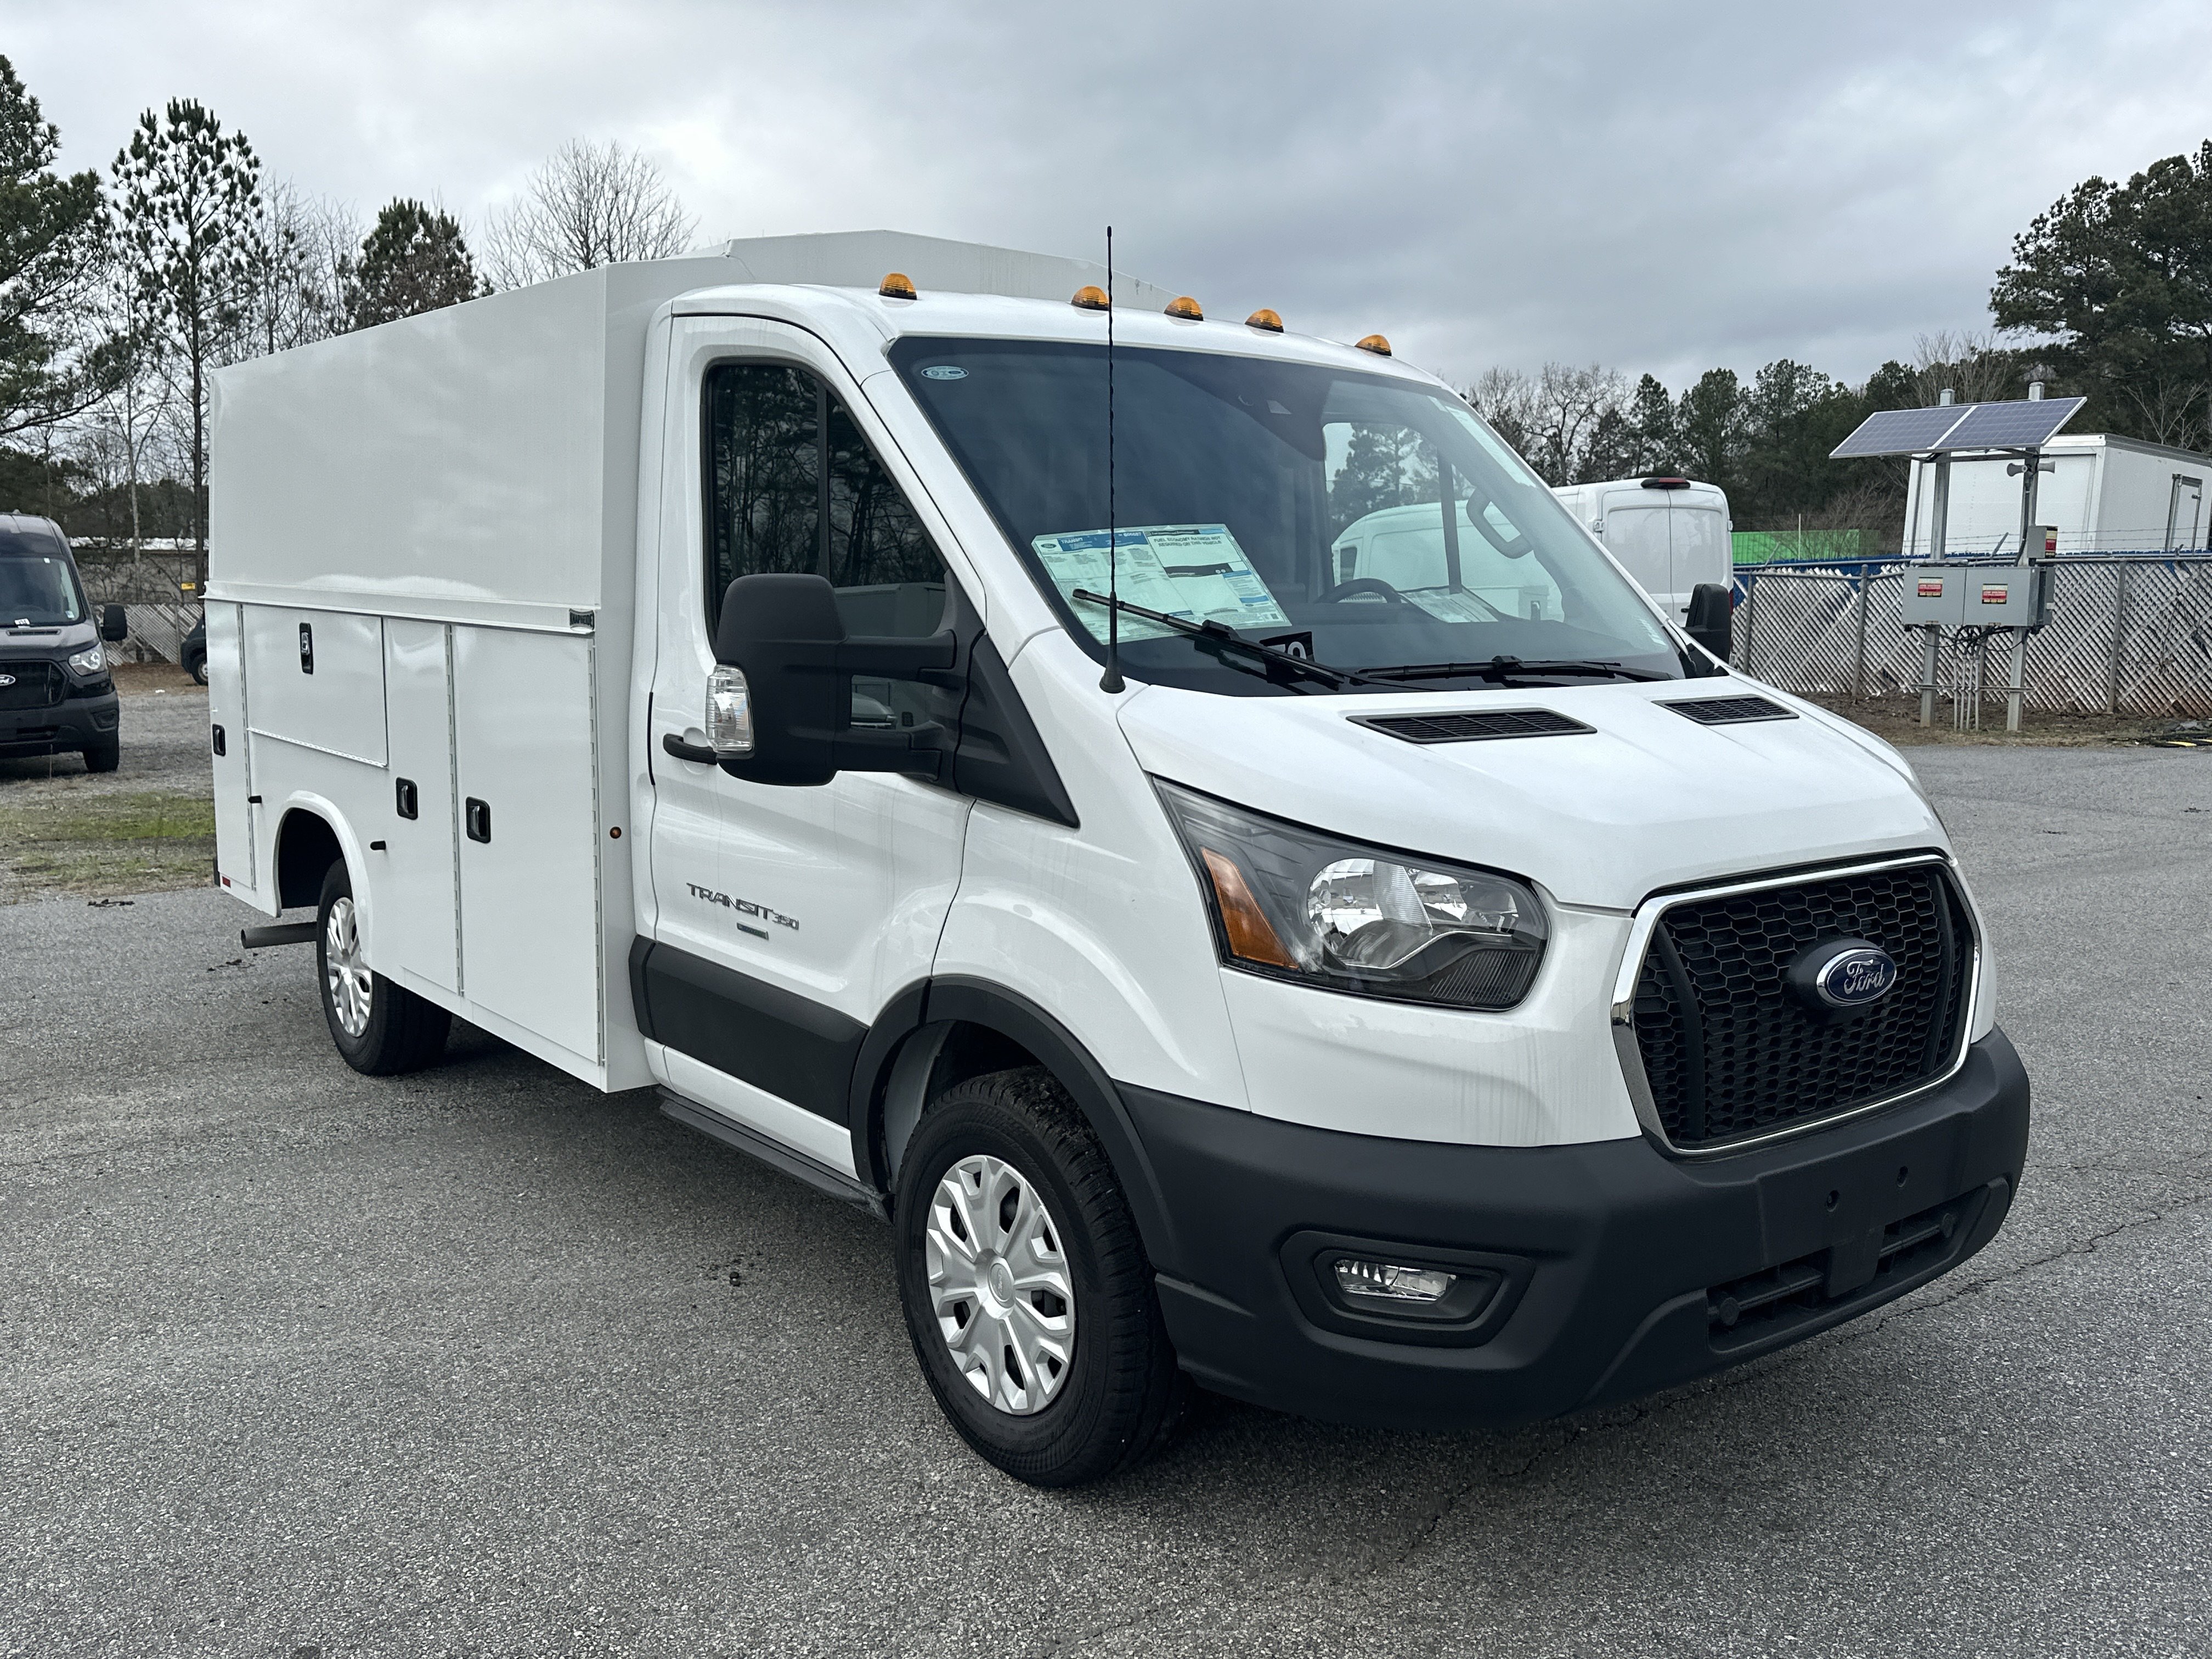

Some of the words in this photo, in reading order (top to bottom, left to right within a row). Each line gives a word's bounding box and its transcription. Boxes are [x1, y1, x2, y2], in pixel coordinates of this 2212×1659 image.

[686, 882, 774, 919] TRANSIT
[772, 912, 799, 930] 350
[1844, 959, 1885, 995] Ford
